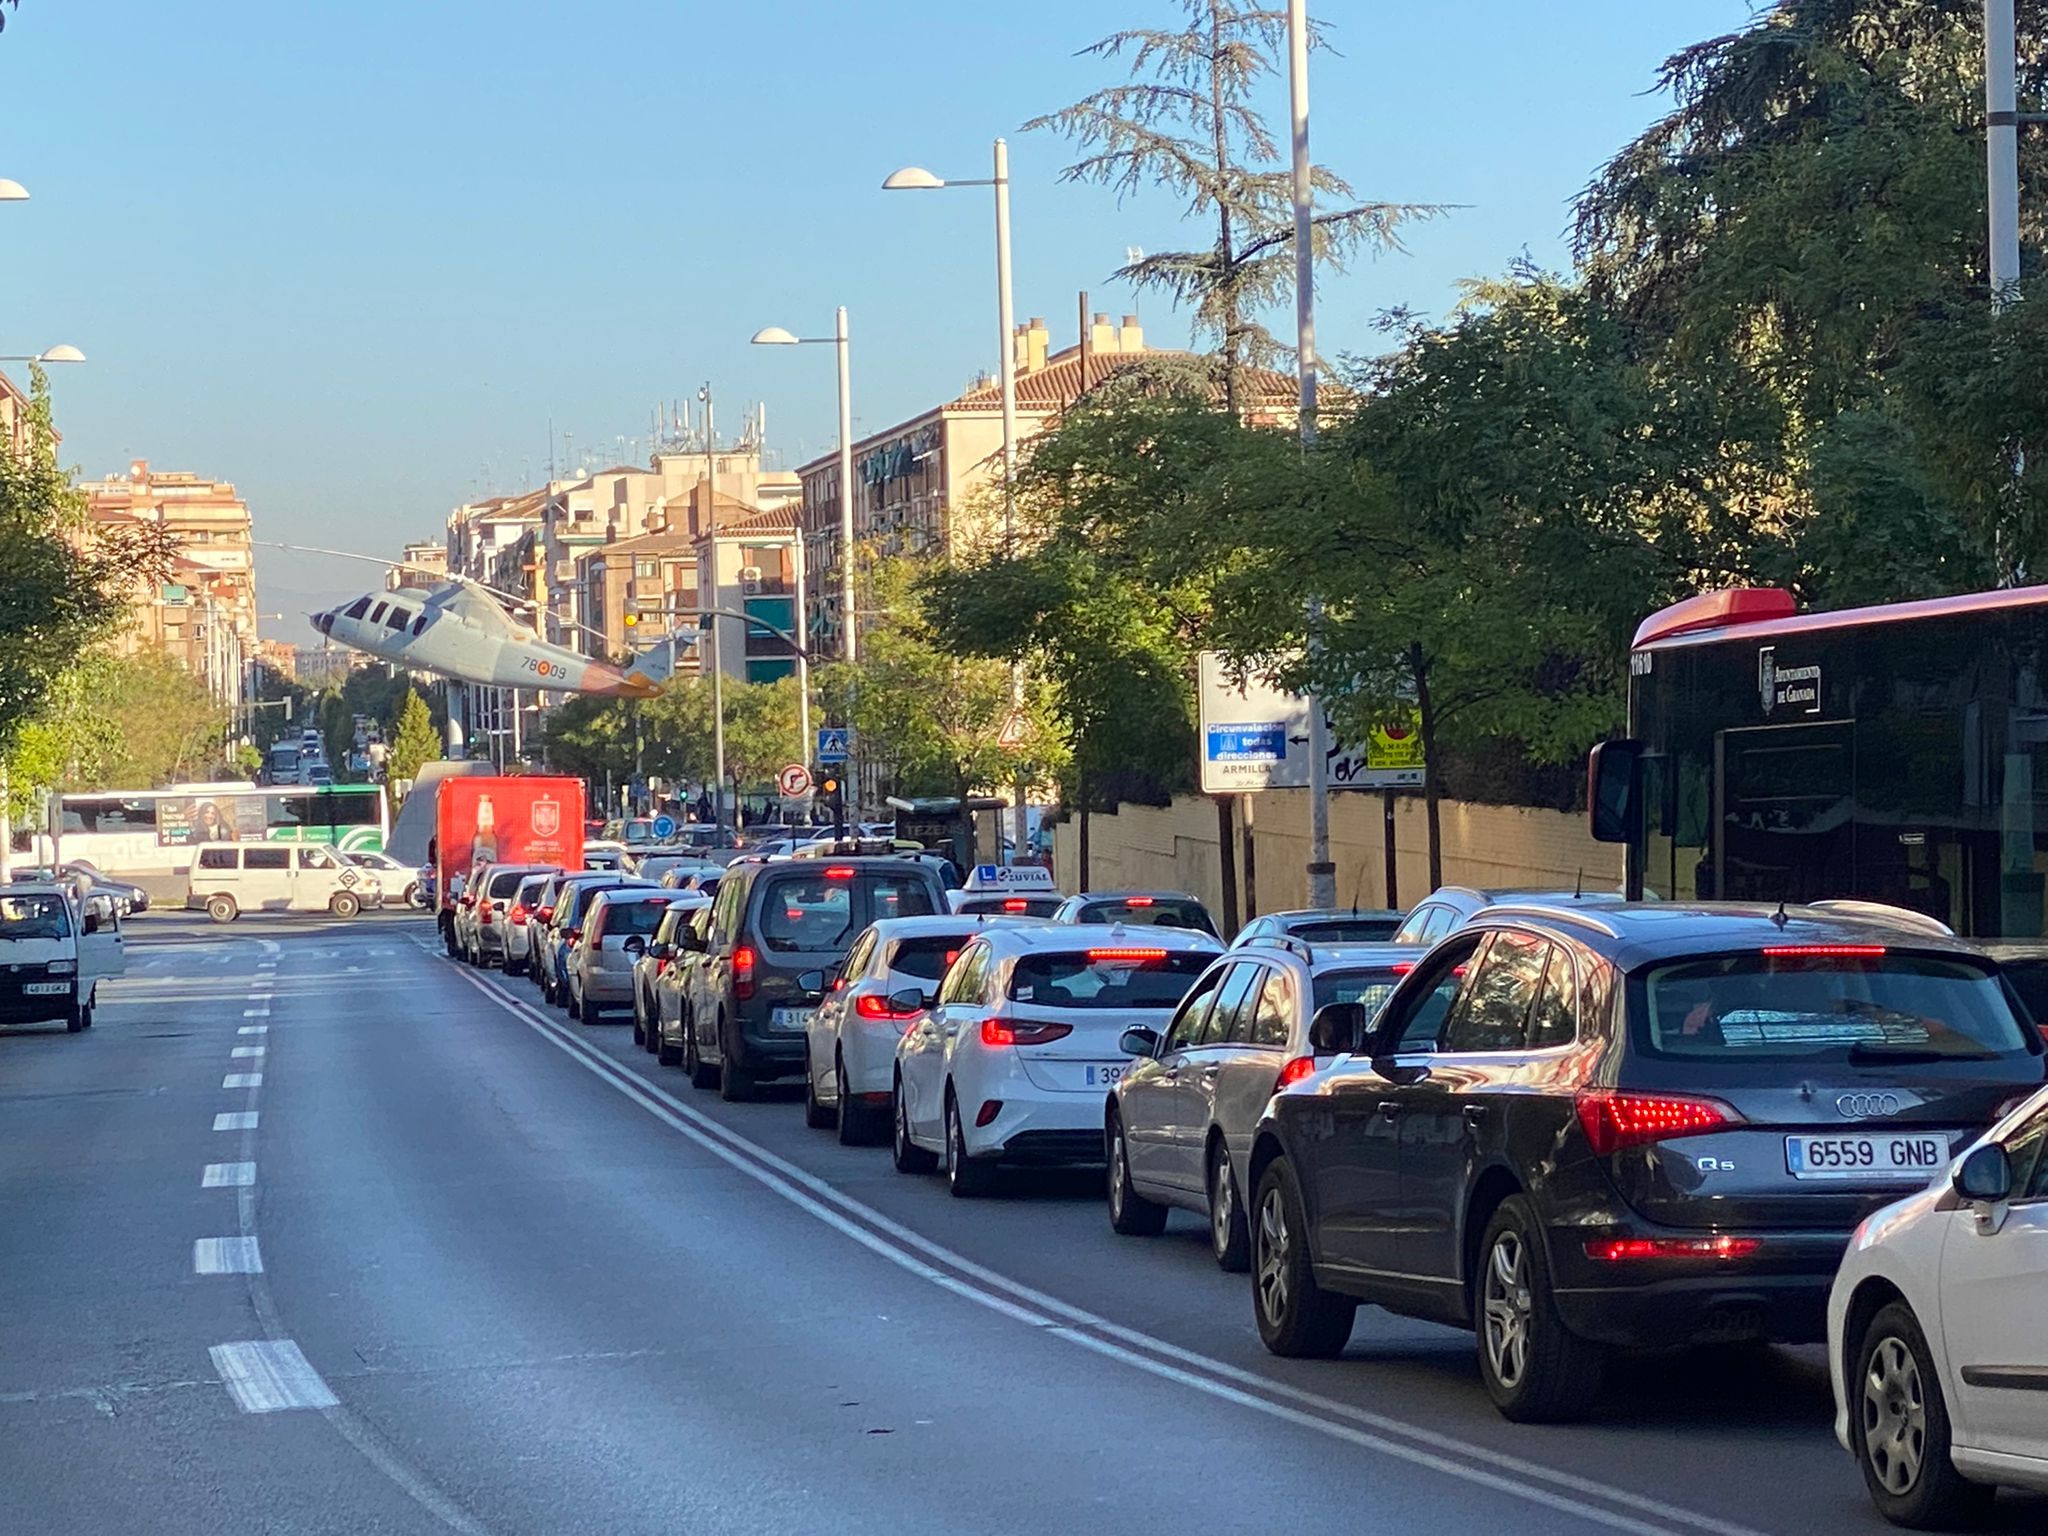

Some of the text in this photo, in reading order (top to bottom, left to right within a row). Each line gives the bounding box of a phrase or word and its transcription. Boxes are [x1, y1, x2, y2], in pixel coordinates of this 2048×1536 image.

[520, 656, 567, 680] 78 09
[1241, 736, 1273, 746] todas
[1216, 750, 1278, 760] direcciones
[1222, 764, 1272, 774] ARMILLA
[983, 868, 992, 880] L
[1101, 1067, 1126, 1084] 39
[1809, 1139, 1938, 1166] 6559 GNB
[1697, 1157, 1735, 1171] Q5
